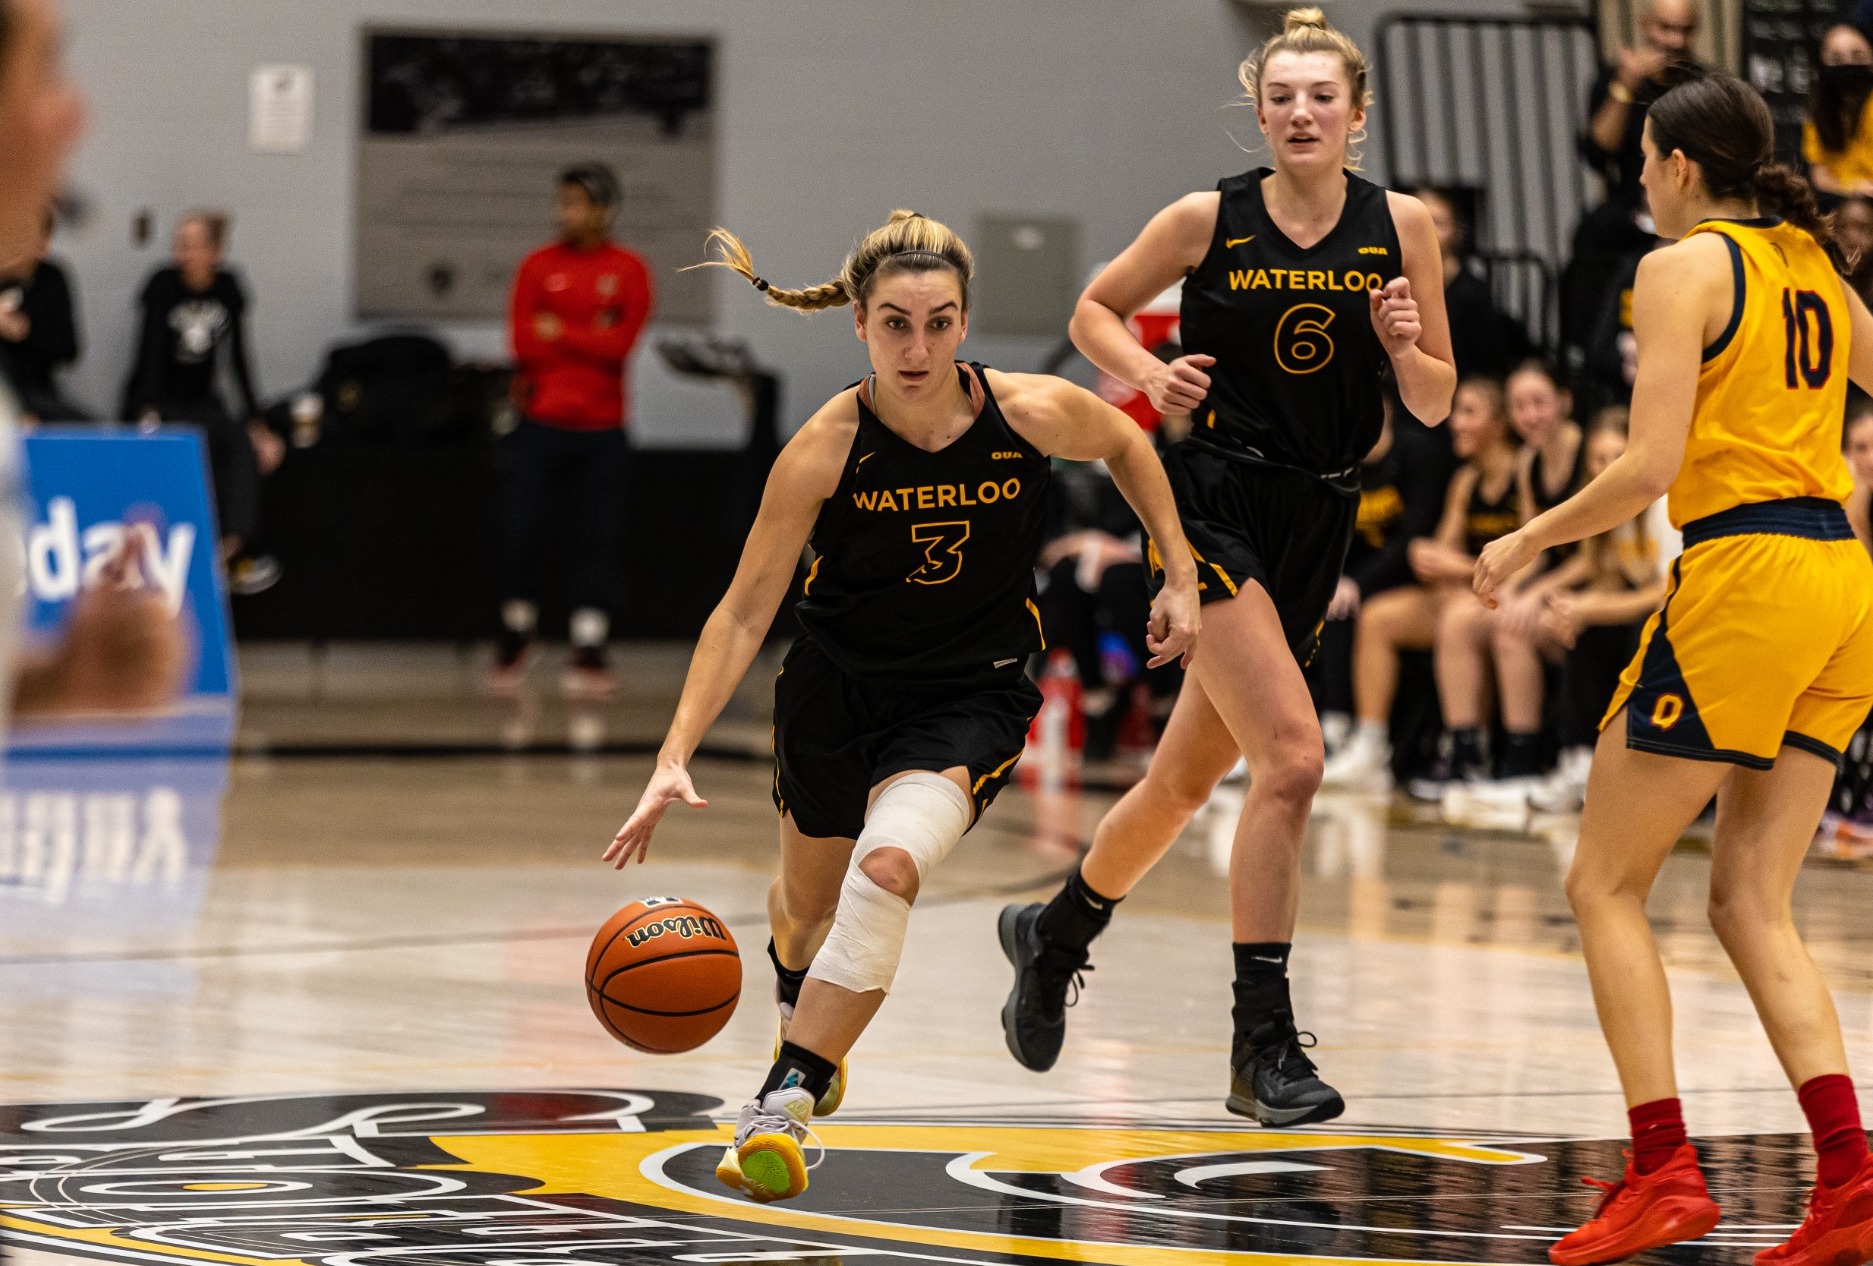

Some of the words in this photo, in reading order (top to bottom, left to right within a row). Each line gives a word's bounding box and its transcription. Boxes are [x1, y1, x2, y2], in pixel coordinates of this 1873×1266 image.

[1358, 246, 1388, 256] OUA
[1229, 268, 1383, 293] WATERLOO
[1273, 302, 1336, 375] 6
[1782, 286, 1834, 390] 10
[991, 451, 1024, 460] OUA
[853, 477, 1022, 512] WATERLOO
[905, 520, 971, 585] 3
[625, 914, 727, 948] Wilson
